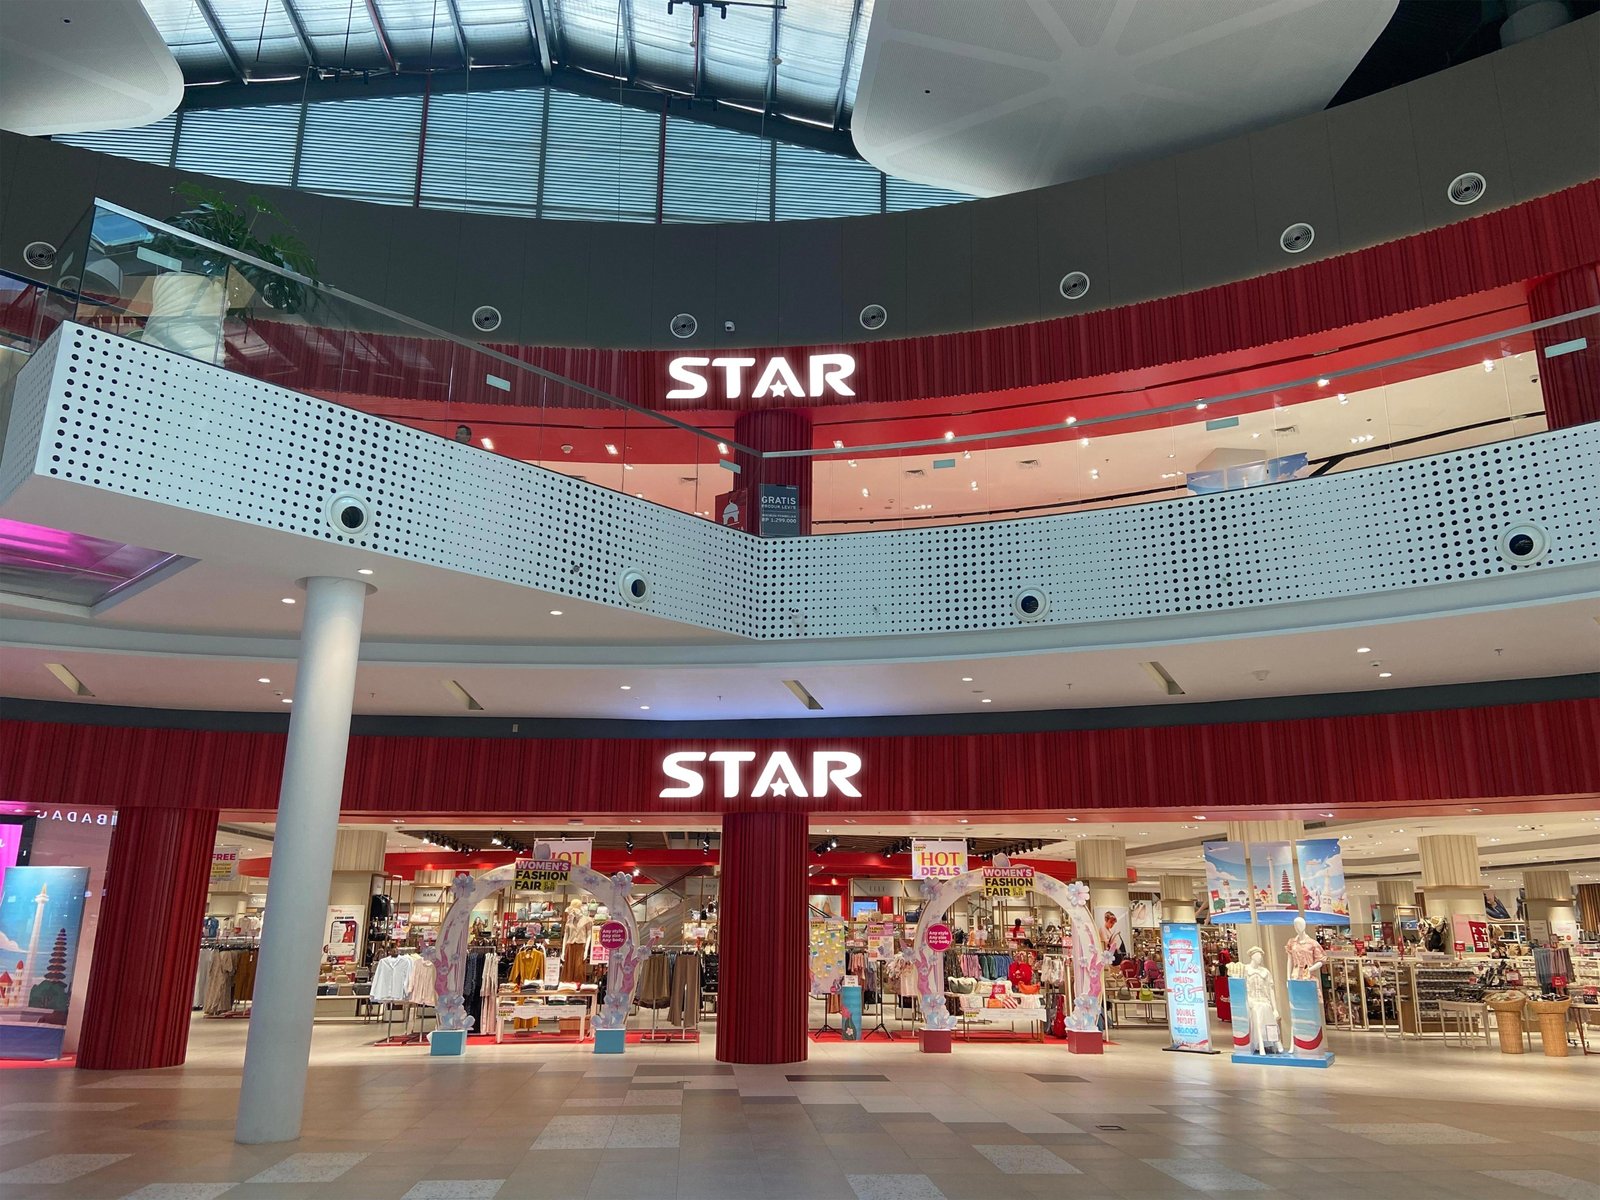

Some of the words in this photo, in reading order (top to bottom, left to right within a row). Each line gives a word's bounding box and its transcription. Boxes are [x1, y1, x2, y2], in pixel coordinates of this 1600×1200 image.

[666, 353, 856, 399] STAR
[761, 496, 796, 505] GRATIS
[659, 751, 863, 798] STAR
[212, 853, 236, 861] FREE
[921, 852, 960, 866] HOT
[517, 861, 569, 871] WOMEN'S
[516, 870, 568, 881] FASHION
[921, 867, 961, 876] DEALS
[984, 868, 1032, 877] WOMEN'S
[515, 881, 541, 890] FAIR
[985, 878, 1033, 887] FASHION
[985, 888, 1010, 896] FAIR
